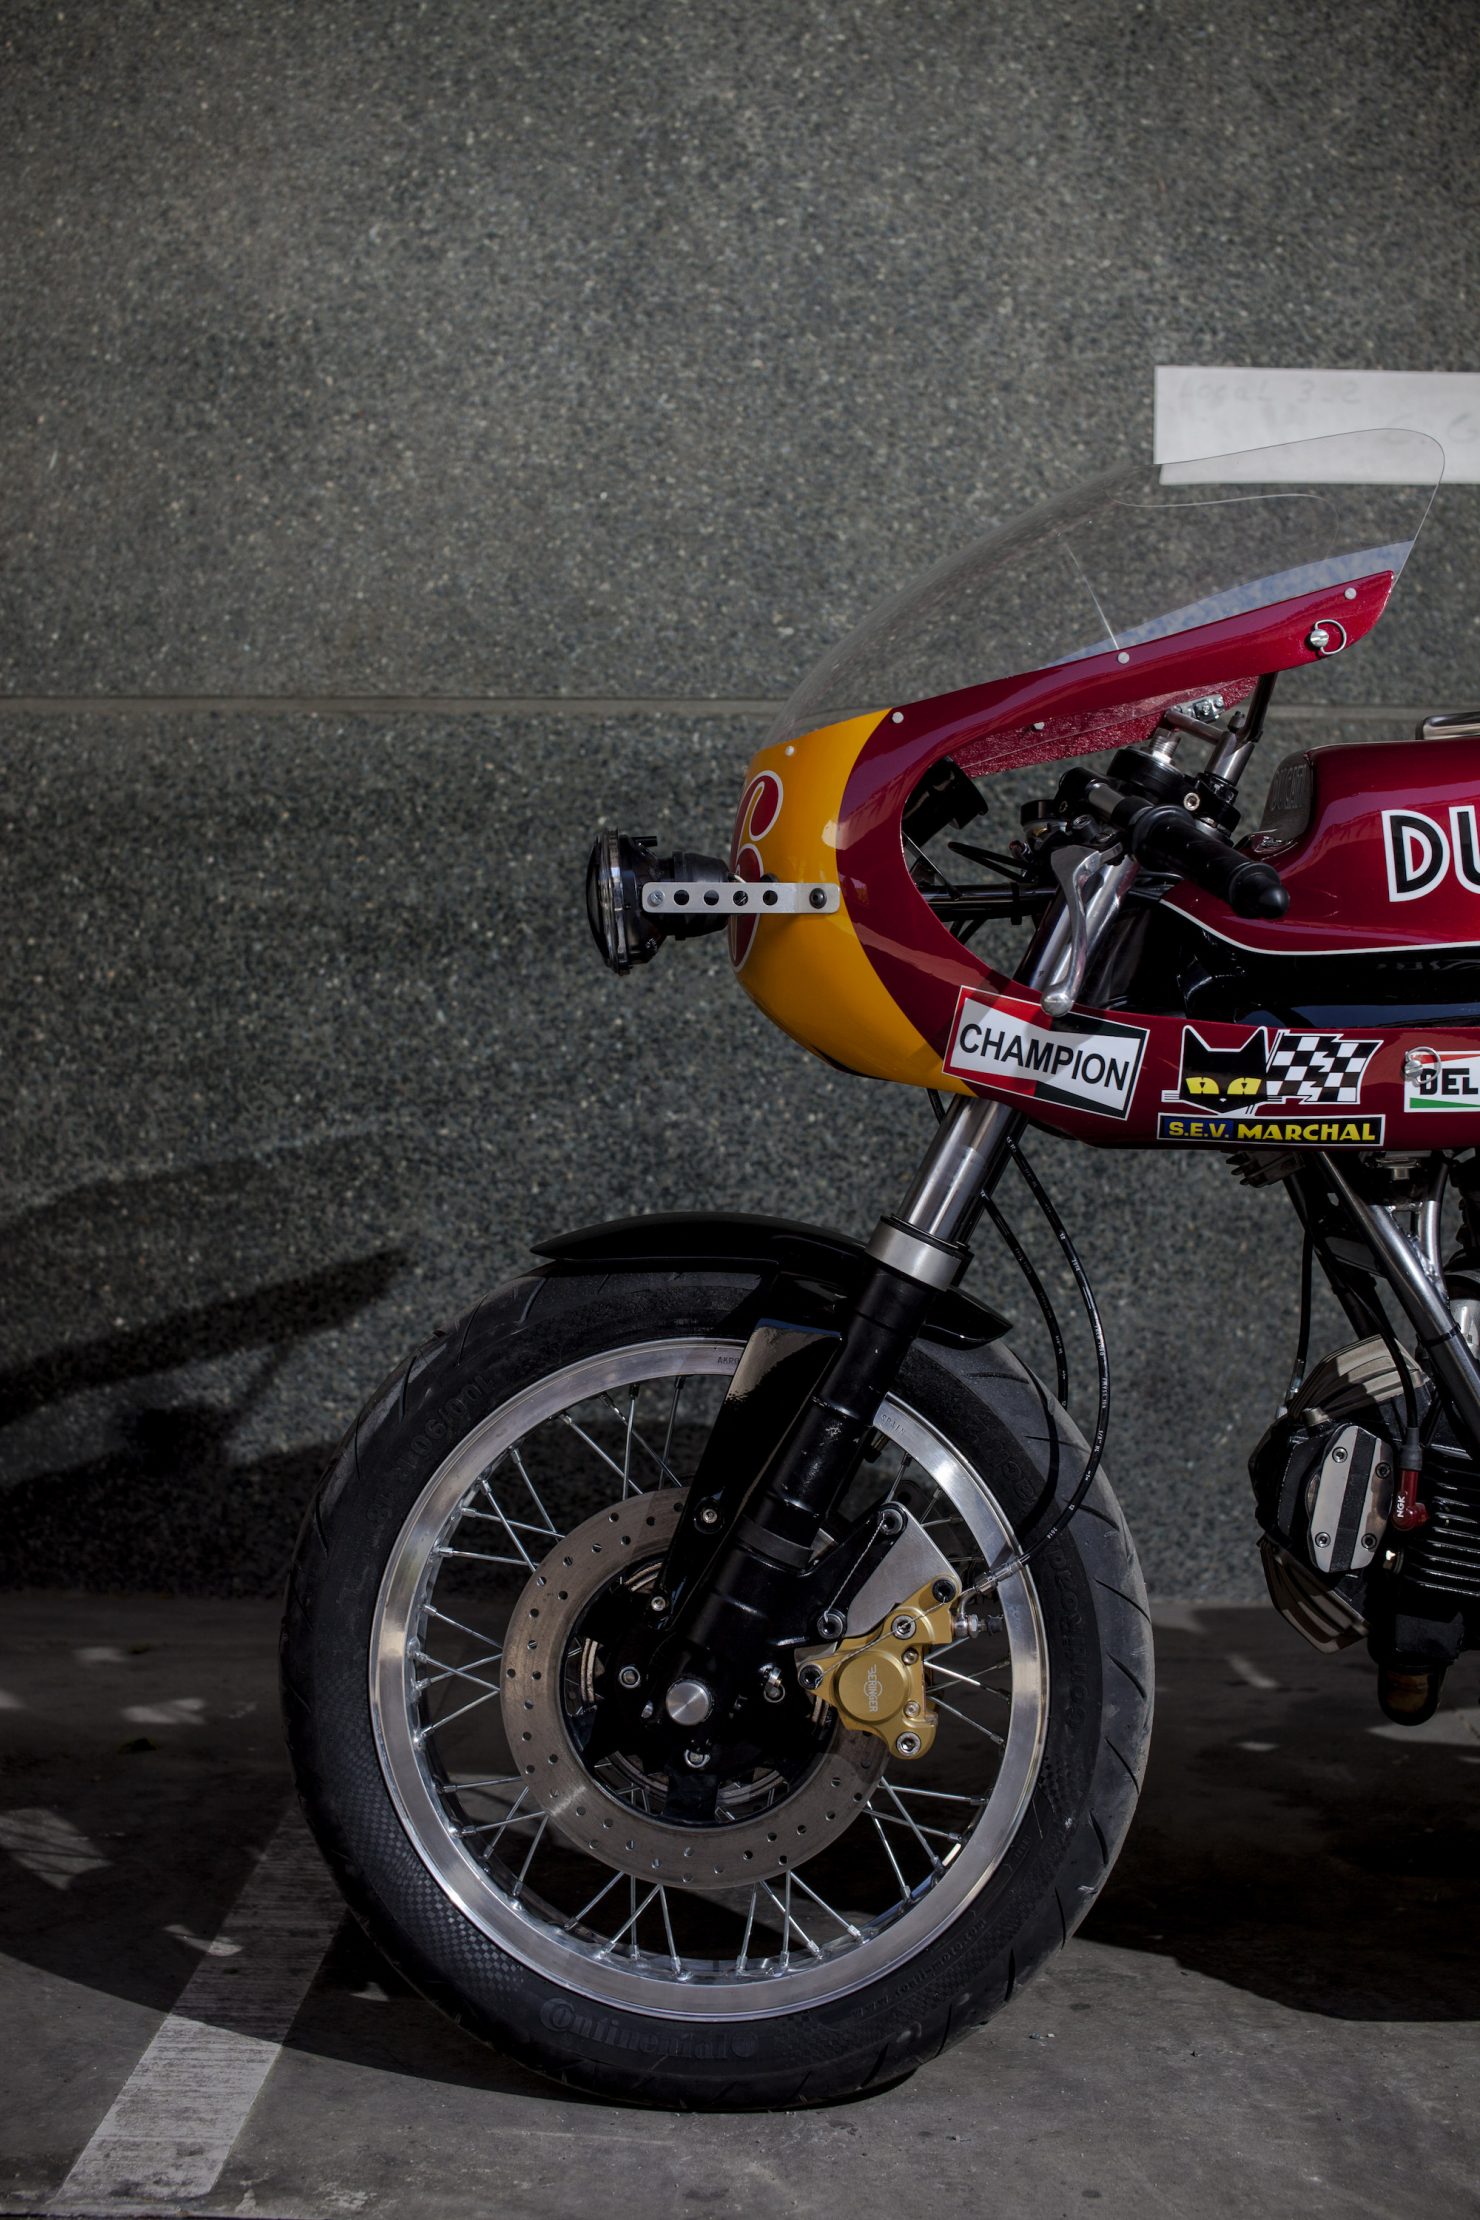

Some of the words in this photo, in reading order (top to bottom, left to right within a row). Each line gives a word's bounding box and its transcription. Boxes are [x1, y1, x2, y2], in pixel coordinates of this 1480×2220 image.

[959, 1022, 1129, 1091] CHAMPION
[1420, 1068, 1479, 1095] DEL
[1169, 1121, 1230, 1138] S.E.V.
[1237, 1121, 1376, 1141] MARCHAL
[1396, 1495, 1406, 1518] NGK
[867, 1664, 878, 1712] BERINGER
[537, 1997, 726, 2058] Continental
